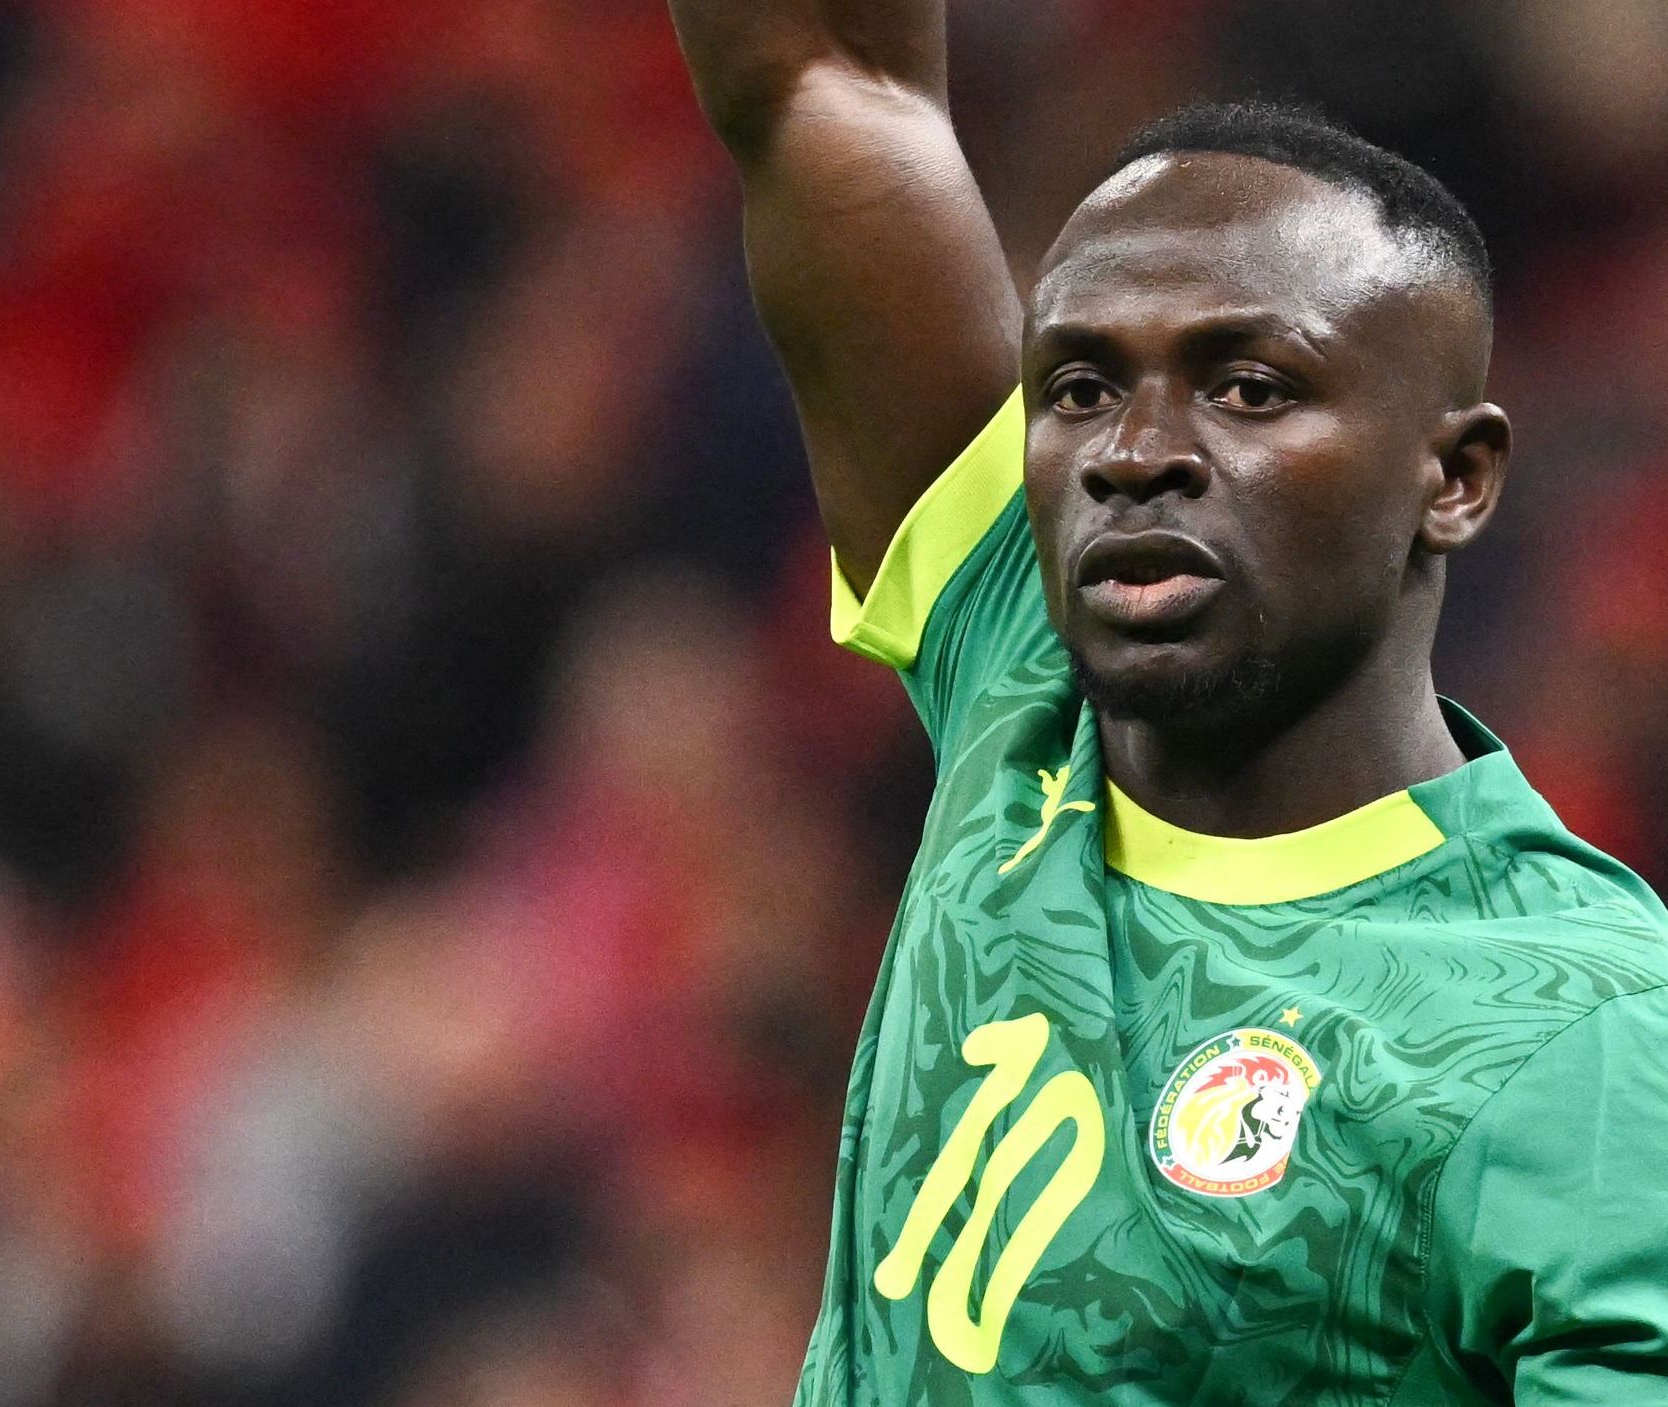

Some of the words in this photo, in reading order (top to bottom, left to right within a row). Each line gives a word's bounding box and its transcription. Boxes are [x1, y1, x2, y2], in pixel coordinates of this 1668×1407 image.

[1155, 1044, 1220, 1150] FÉDÉRATION
[873, 1011, 1106, 1375] 10
[1179, 1169, 1271, 1192] FOOTBALL
